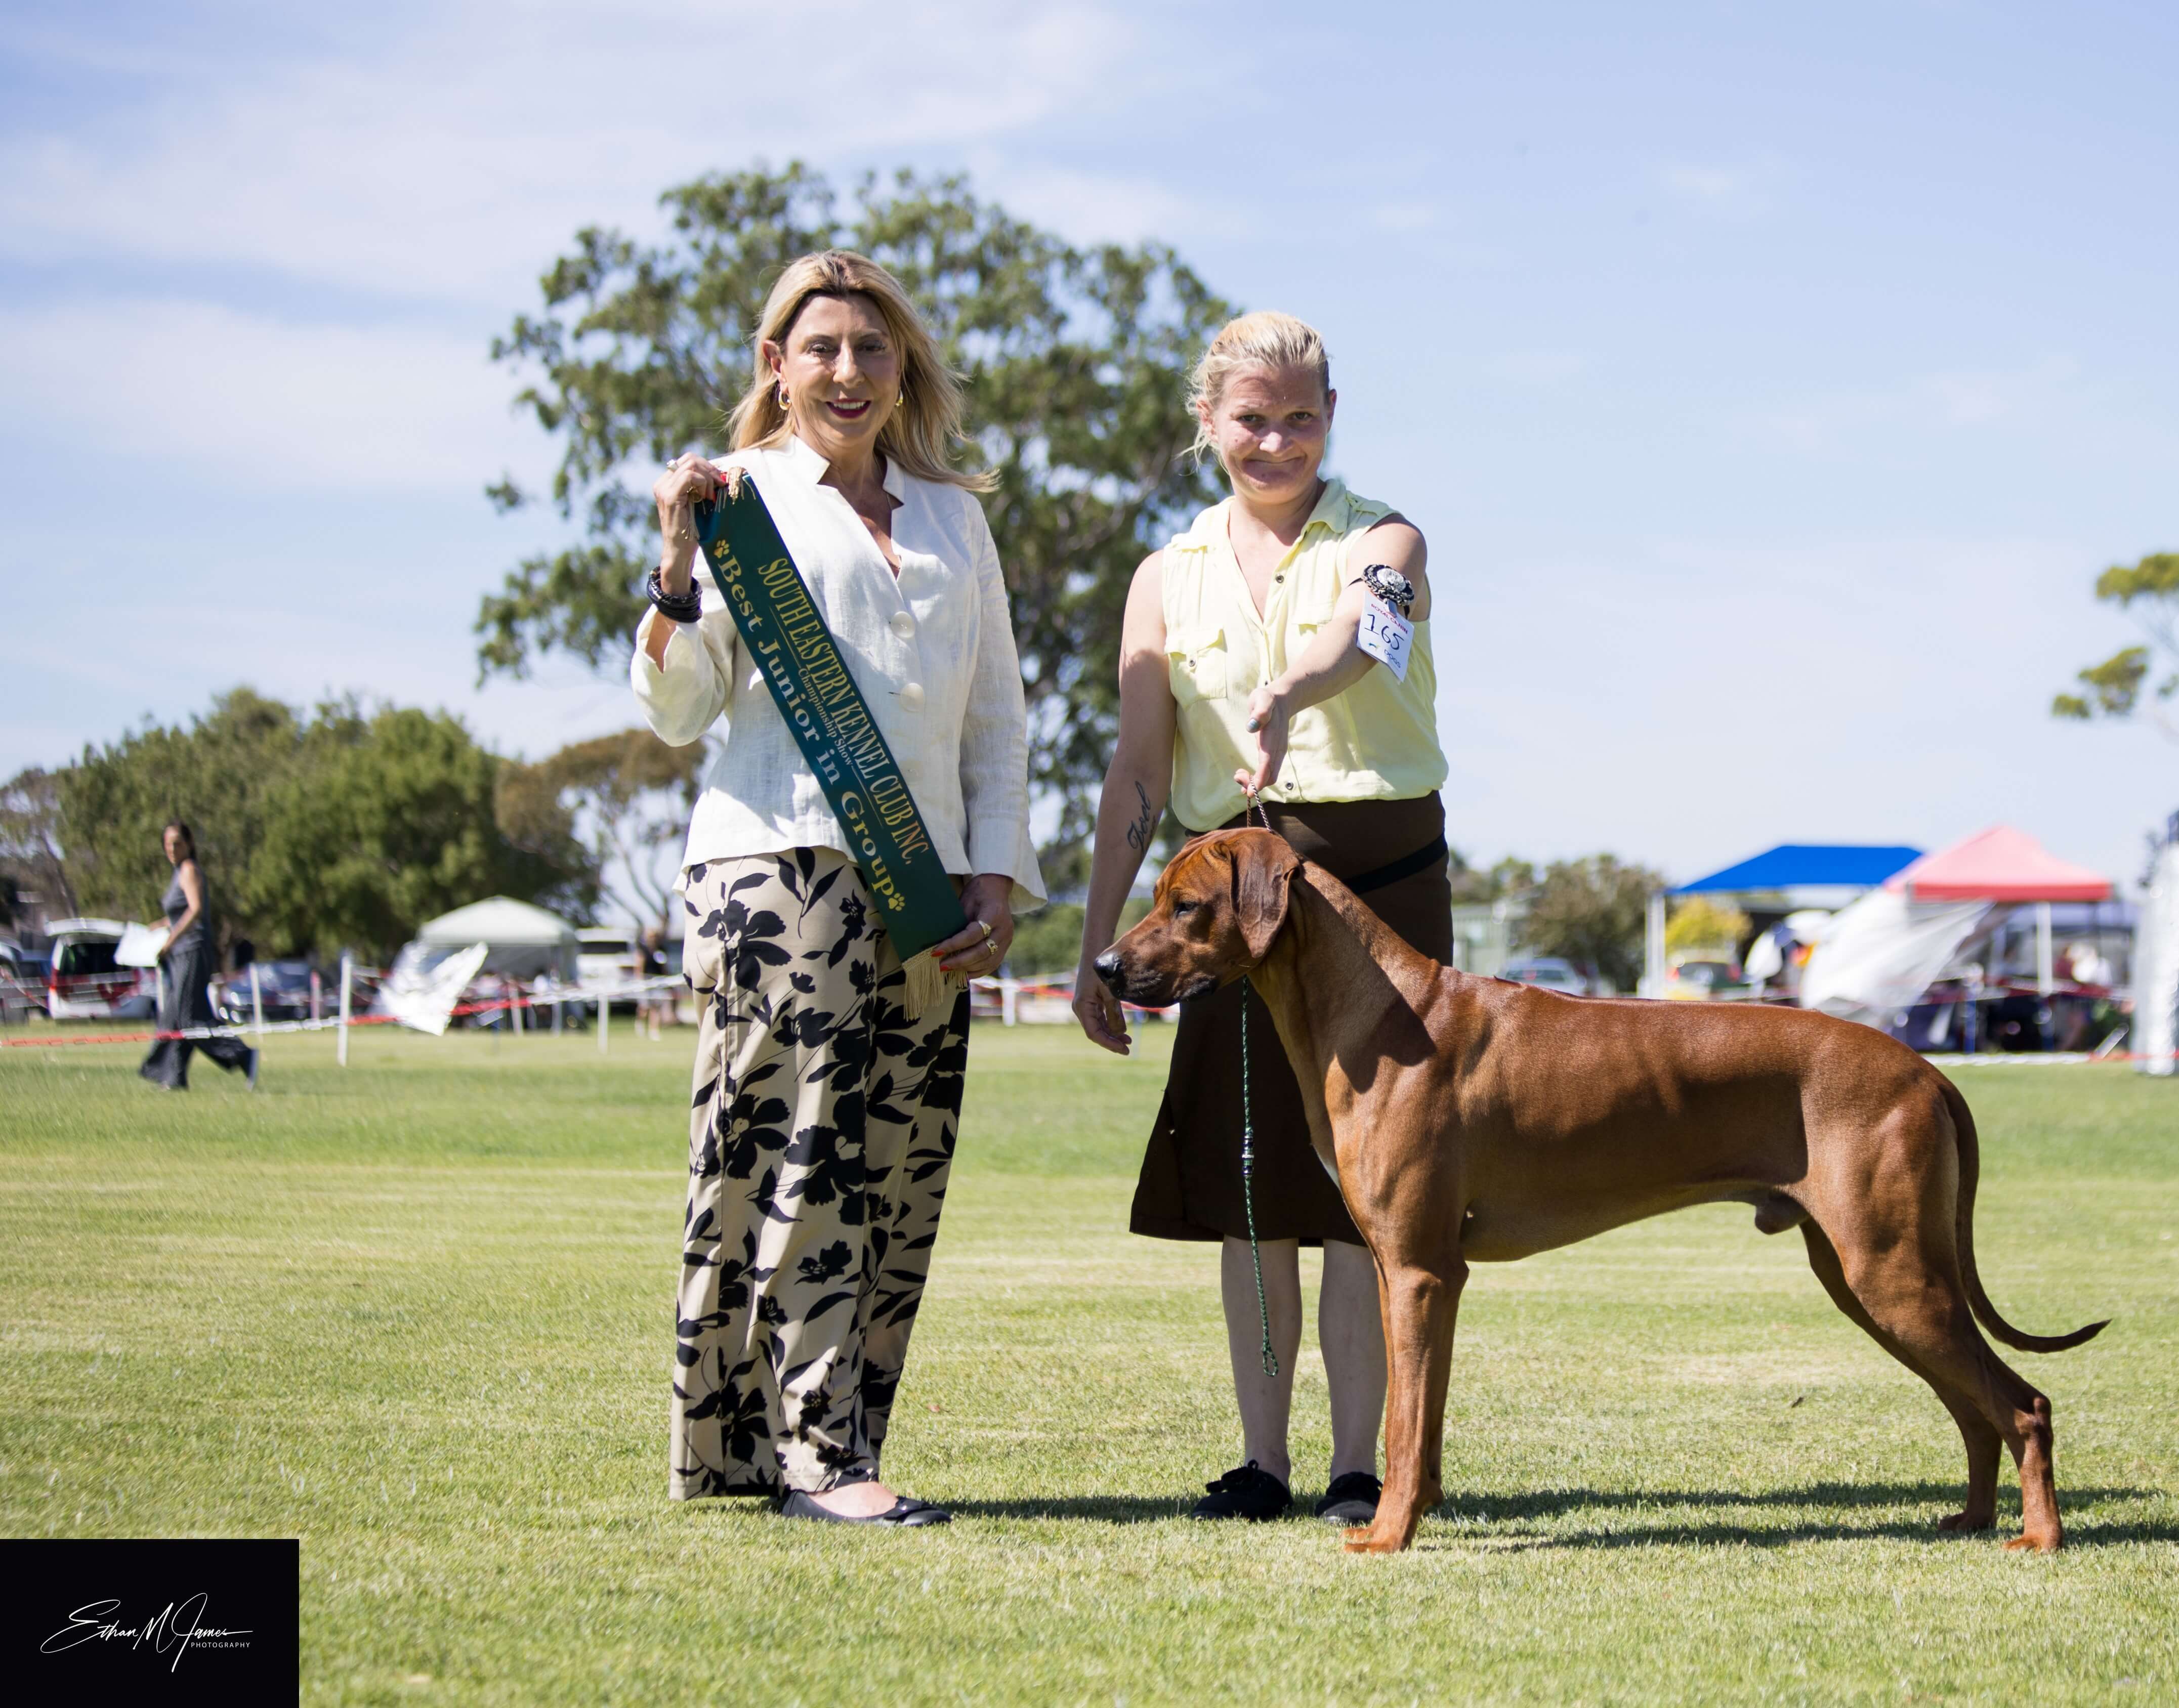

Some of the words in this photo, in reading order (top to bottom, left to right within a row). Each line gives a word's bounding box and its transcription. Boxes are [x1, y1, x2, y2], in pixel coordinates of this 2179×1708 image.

[1364, 614, 1404, 650] 165
[1371, 604, 1389, 619] ROYAL
[1390, 617, 1408, 634] CANIN
[718, 555, 763, 633] Best
[758, 638, 820, 742] Junior
[816, 748, 842, 785] in
[841, 791, 895, 897] Group
[758, 558, 814, 626] SOUTH
[789, 620, 855, 706] EASTERN
[831, 702, 890, 779] KENNEL
[870, 775, 914, 826] CLUB
[892, 820, 930, 866] INC.
[798, 667, 838, 738] Championship
[834, 738, 853, 766] Show
